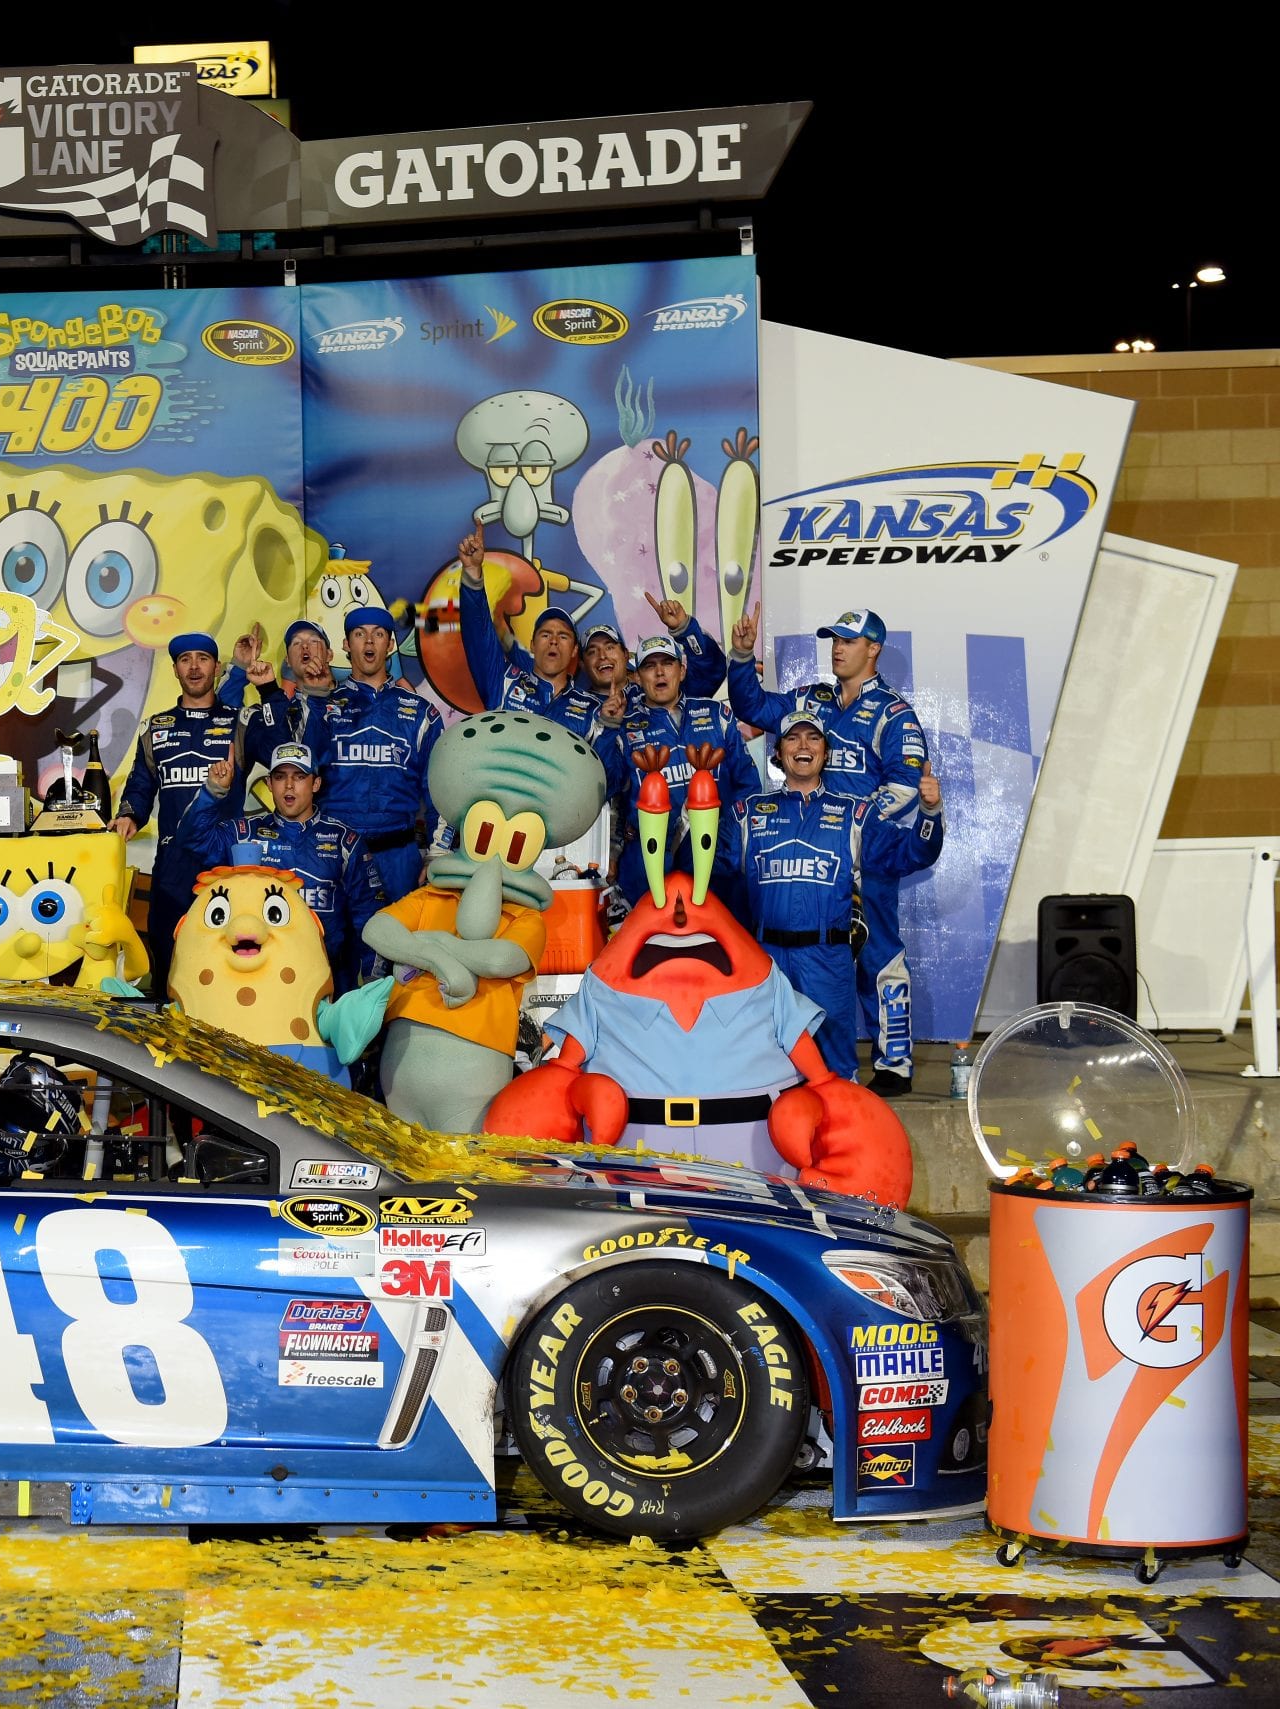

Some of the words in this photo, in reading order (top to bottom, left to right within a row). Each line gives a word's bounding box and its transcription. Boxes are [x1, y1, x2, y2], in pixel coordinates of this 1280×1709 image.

[26, 71, 181, 97] GATORADE
[26, 100, 182, 139] VICTORY
[31, 139, 124, 176] LANE
[334, 122, 743, 209] GATORADE
[559, 307, 592, 319] NASCAR
[655, 306, 730, 325] KANSAS
[226, 329, 260, 339] NASCAR
[420, 319, 485, 345] Sprint
[564, 319, 597, 332] Sprint
[652, 321, 727, 332] SPEEDWAY
[232, 339, 264, 352] Sprint
[319, 327, 389, 347] KANSAS
[317, 343, 385, 354] SPEEDWAY
[14, 349, 131, 372] SQUAREPANTS
[776, 489, 1035, 545] KANSAS
[769, 543, 1023, 568] SPEEDWAY
[338, 741, 406, 763] LOWE'S
[162, 763, 212, 784] LOWE'
[761, 856, 830, 880] LOWE'S
[529, 994, 574, 1003] GATORAD
[325, 1163, 364, 1177] NASCAR
[298, 1177, 336, 1185] RACE
[338, 1178, 368, 1186] CAR
[306, 1203, 340, 1212] NASCAR
[312, 1210, 345, 1224] Sprint
[380, 1214, 436, 1224] MECHANIX
[382, 1229, 446, 1253] Holley
[442, 1231, 482, 1251] EFI
[582, 1227, 751, 1266] GOODYEAR
[292, 1246, 328, 1260] Coors
[327, 1251, 361, 1260] LIGHT
[312, 1261, 339, 1270] POLE
[380, 1259, 451, 1297] 3M
[290, 1303, 364, 1321] Duralast
[1102, 1253, 1204, 1369] G
[308, 1322, 344, 1331] BRAKES
[851, 1322, 938, 1348] MOOG
[284, 1333, 372, 1356] FLOWMASTER
[736, 1301, 793, 1413] EAGLE
[857, 1351, 943, 1378] MAHLE
[306, 1373, 377, 1386] freescale
[863, 1384, 929, 1405] COMP
[908, 1396, 938, 1406] CAMS
[529, 1302, 635, 1517] GOODYEAR
[861, 1416, 927, 1438] Edelbrock
[860, 1460, 908, 1475] SUNOCO
